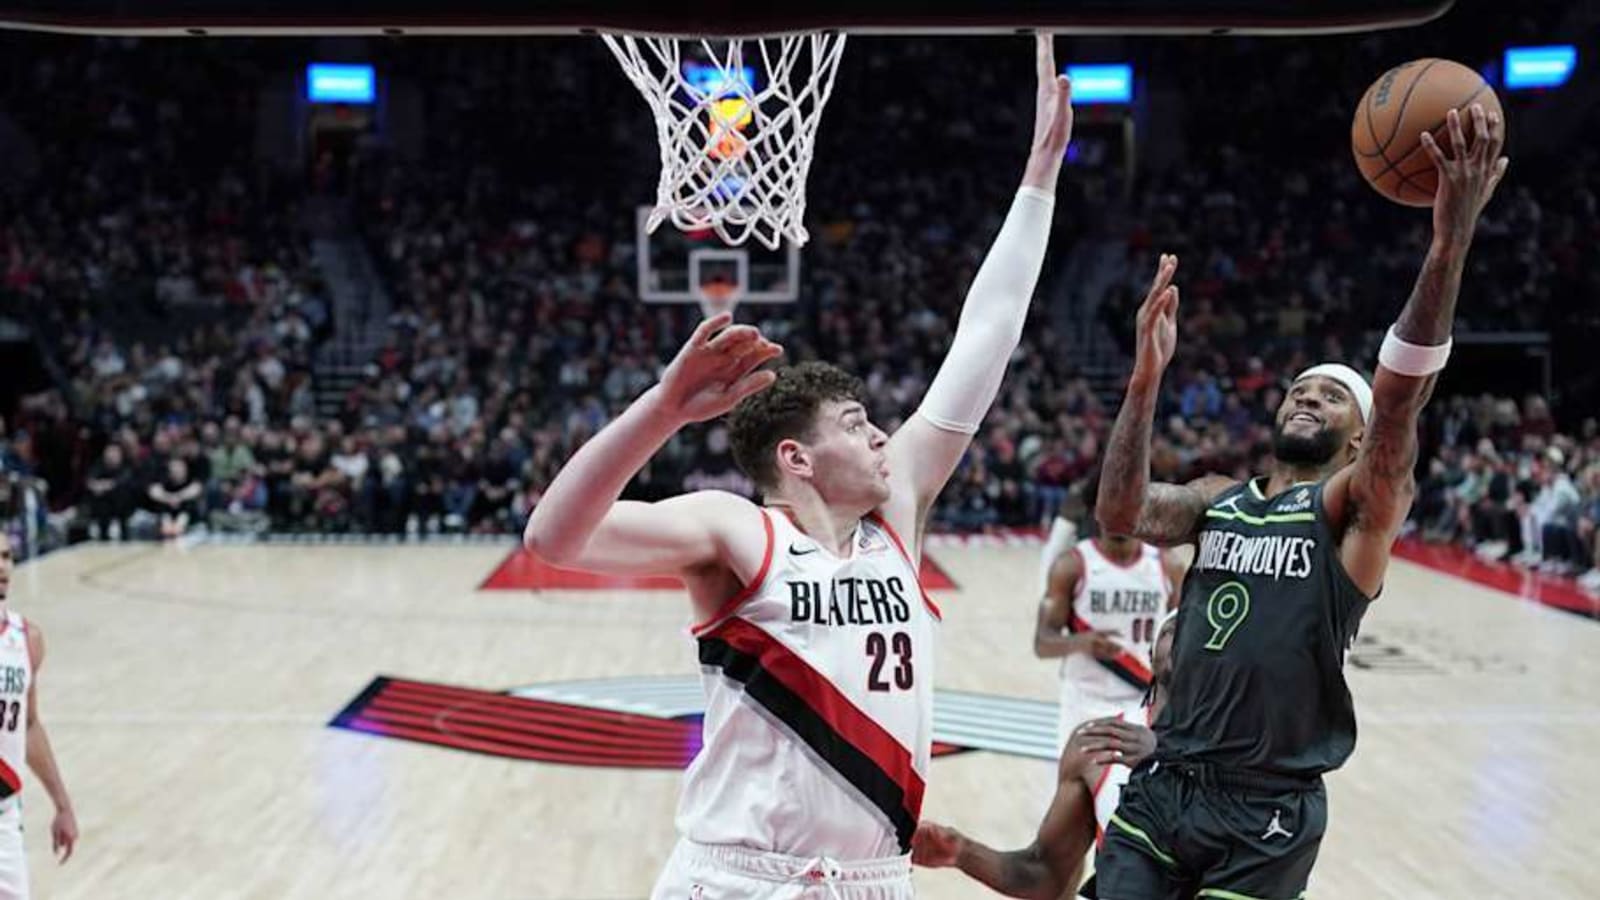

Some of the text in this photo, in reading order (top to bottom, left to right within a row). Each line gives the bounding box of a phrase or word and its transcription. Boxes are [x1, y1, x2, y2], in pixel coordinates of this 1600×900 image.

[786, 576, 910, 626] BLAZERS
[1090, 589, 1161, 613] BLAZERS
[1205, 581, 1250, 650] 9
[866, 631, 914, 692] 23
